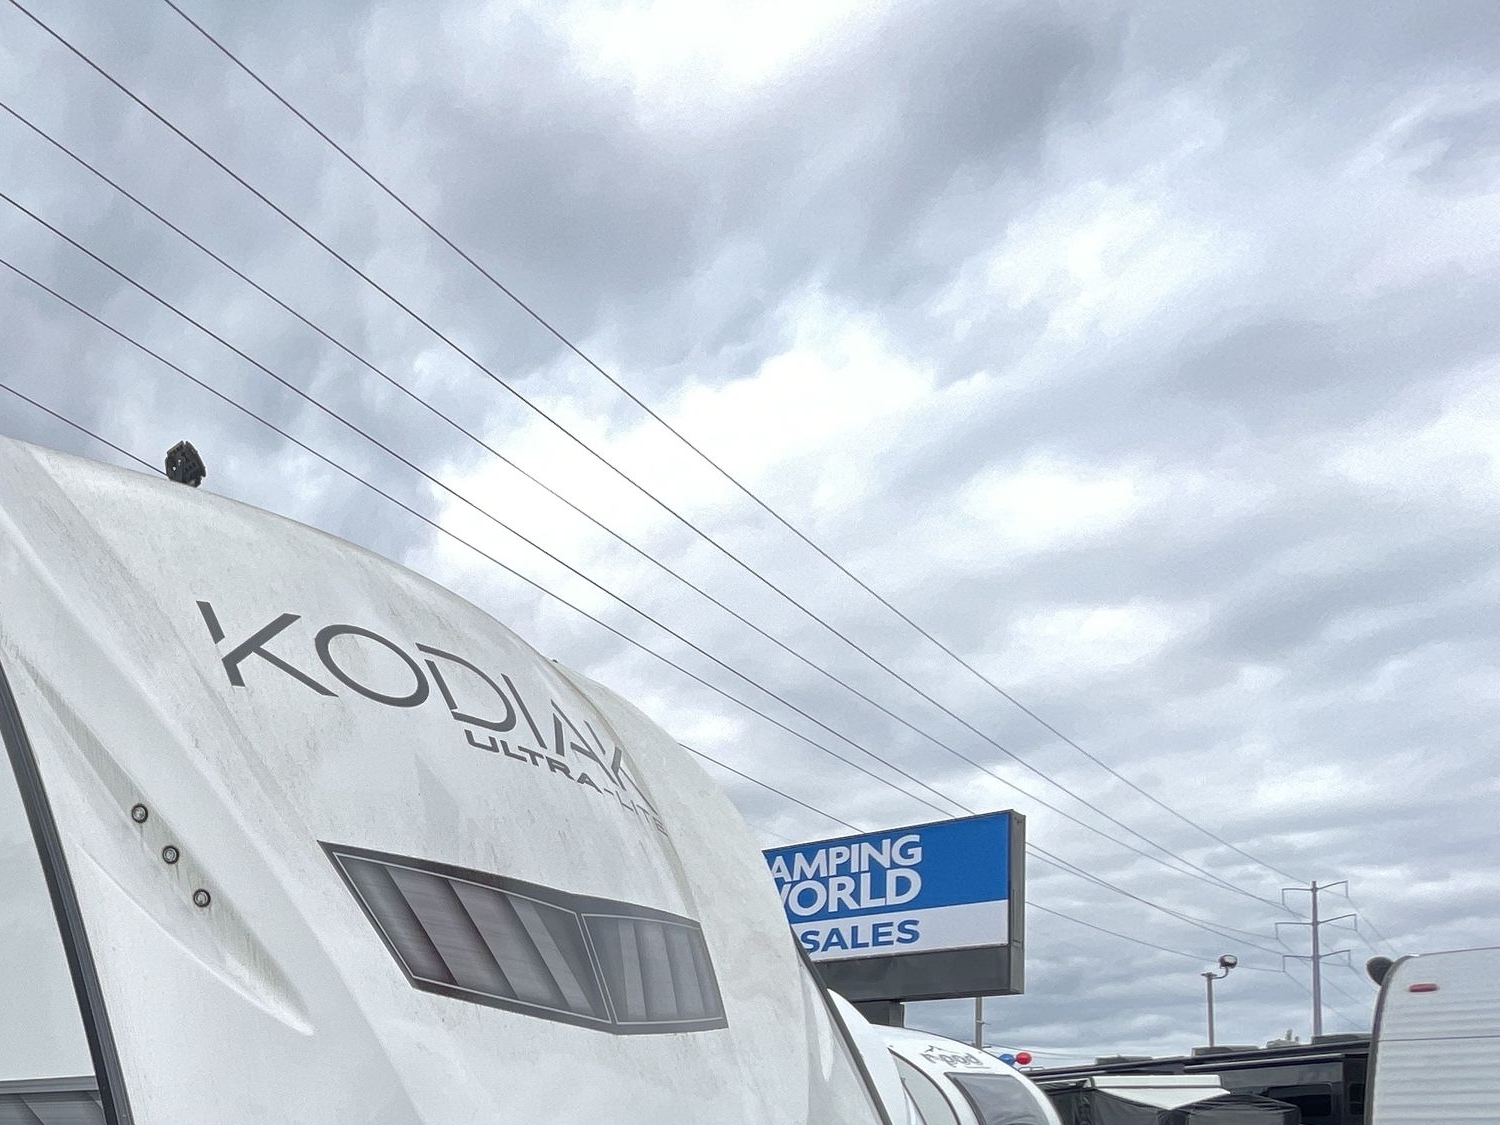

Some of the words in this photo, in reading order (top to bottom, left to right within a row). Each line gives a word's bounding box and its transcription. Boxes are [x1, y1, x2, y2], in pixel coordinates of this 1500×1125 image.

[196, 600, 659, 815] KODIAK
[464, 729, 669, 837] ULTRA-LITE
[770, 834, 923, 882] AMPING
[801, 919, 920, 954] SALES
